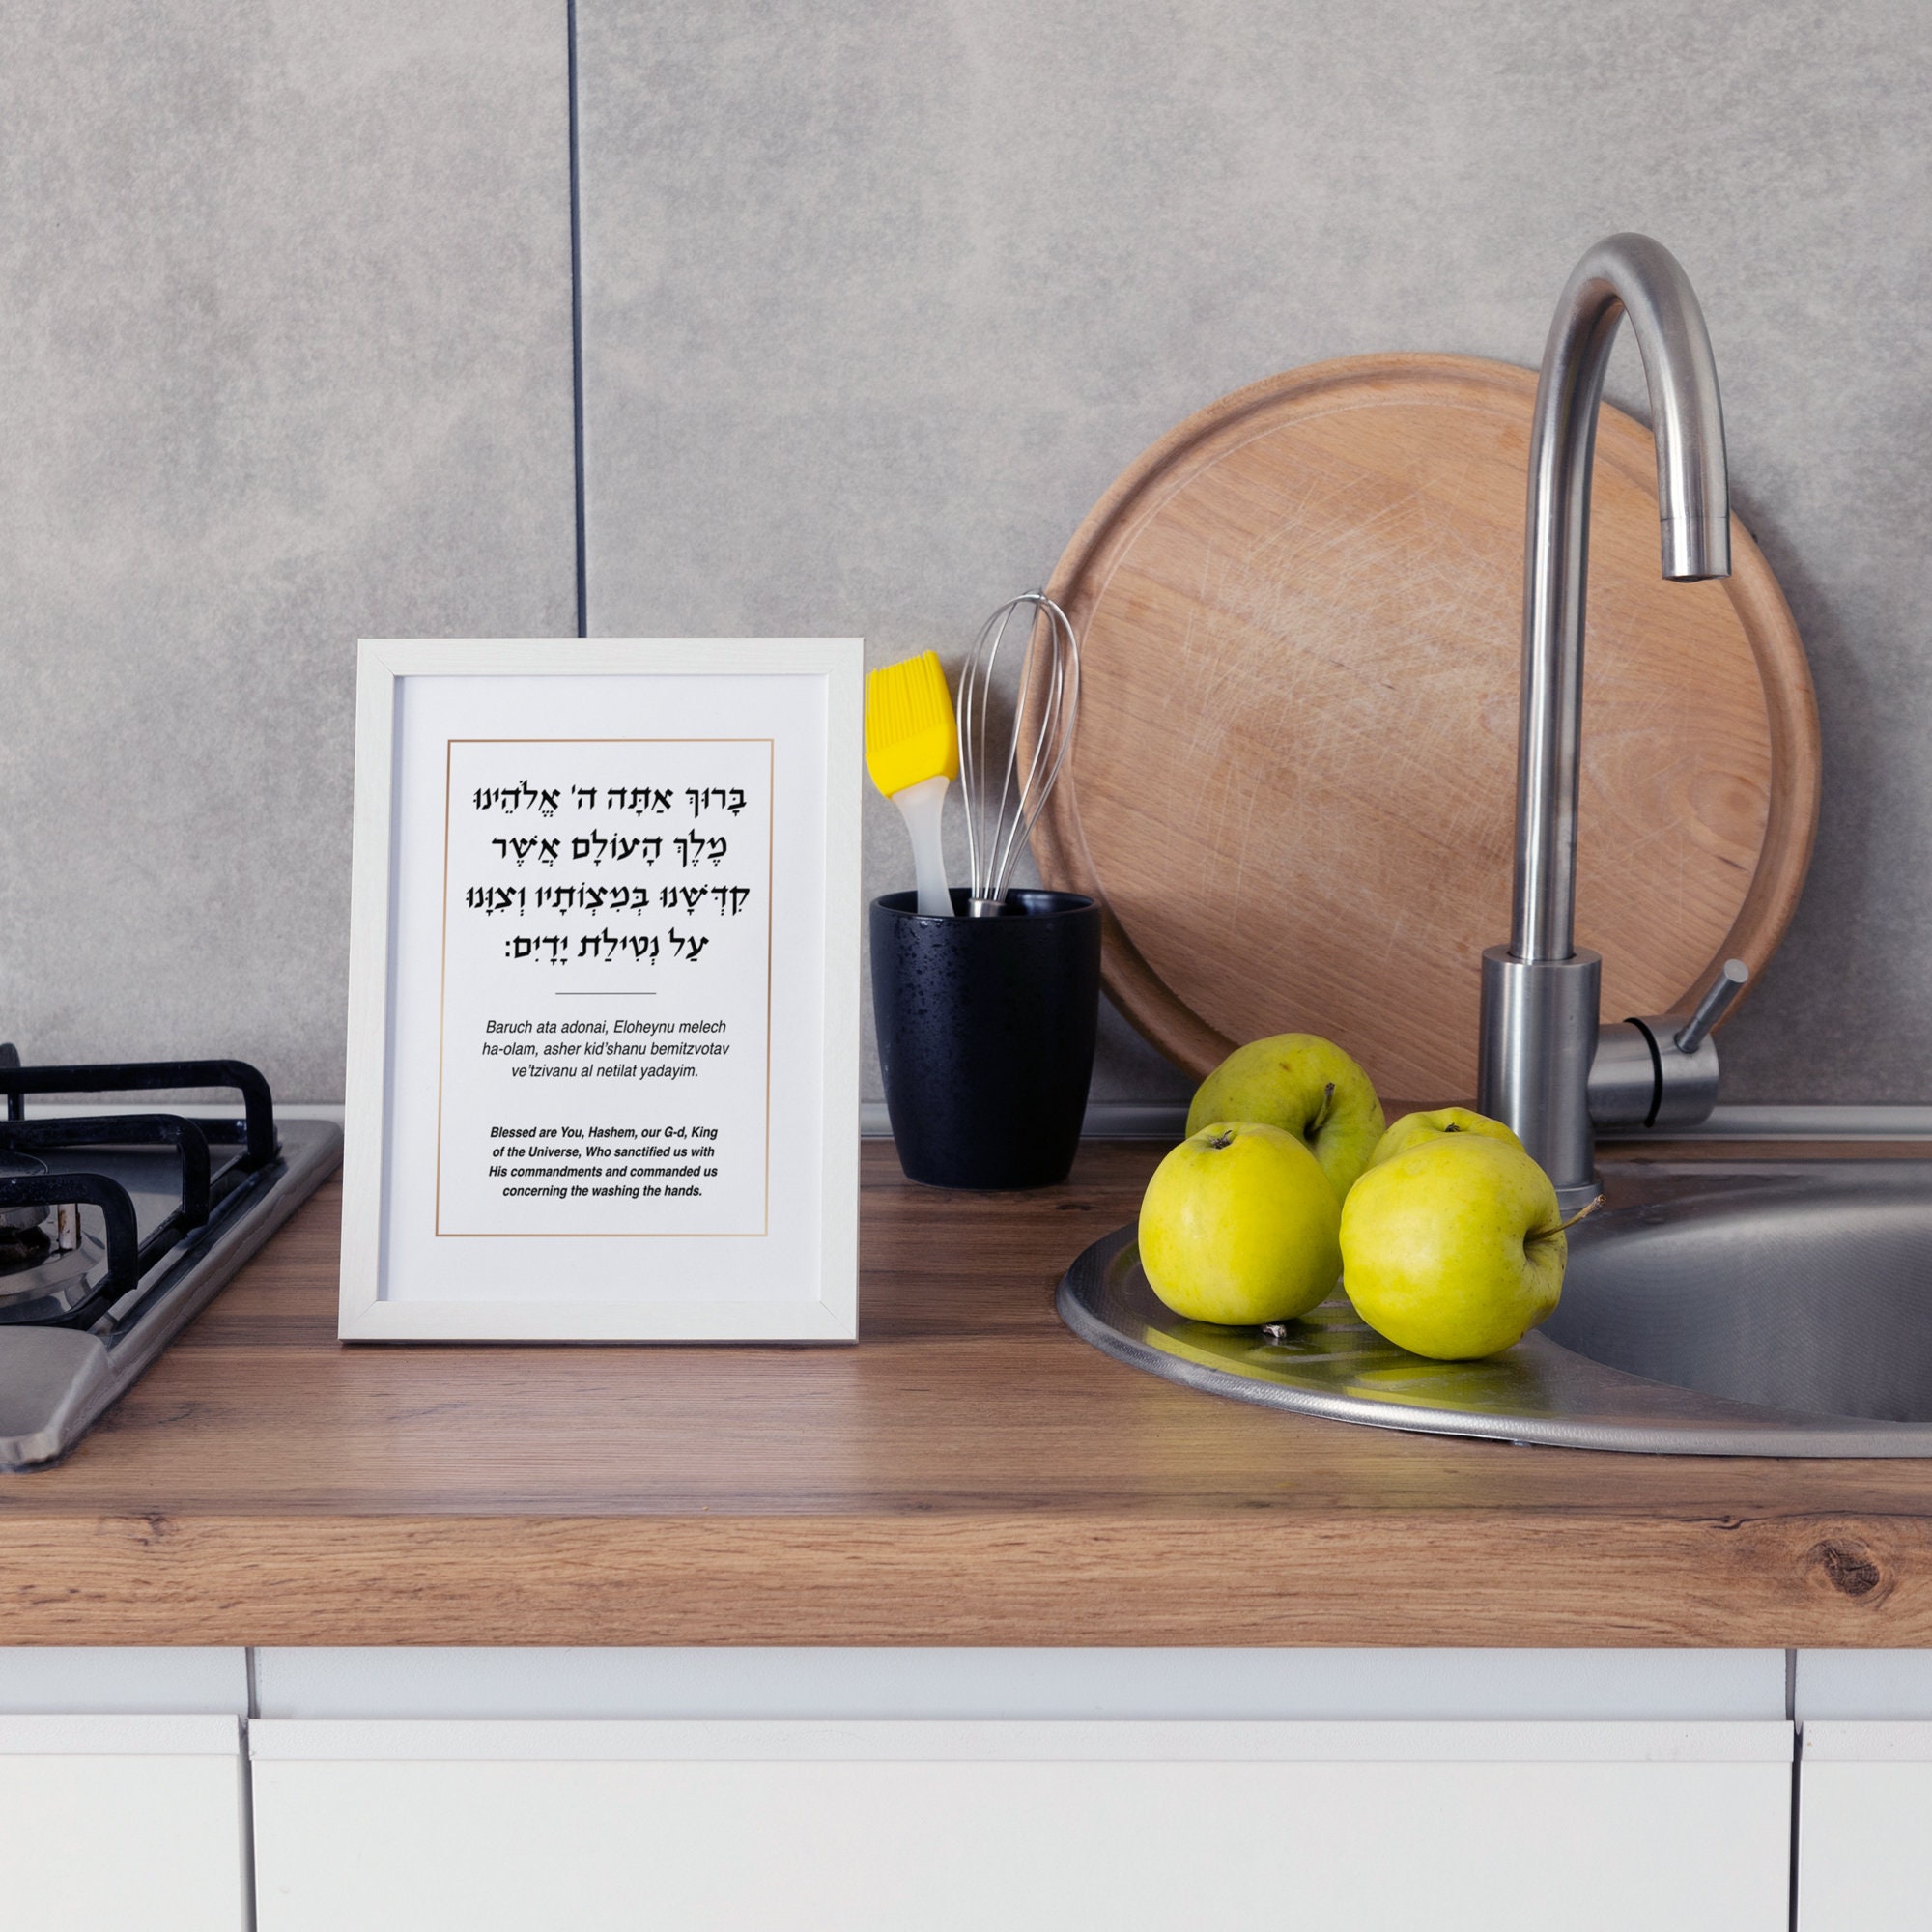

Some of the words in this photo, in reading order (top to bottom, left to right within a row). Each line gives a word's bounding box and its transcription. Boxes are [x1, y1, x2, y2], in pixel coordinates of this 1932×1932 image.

[485, 1019, 533, 1034] Baruch
[536, 1020, 557, 1034] ata
[560, 1019, 609, 1036] adonai,
[613, 1019, 675, 1037] Eloheynu
[678, 1019, 727, 1034] melech
[481, 1041, 539, 1058] ha-olam,
[543, 1041, 582, 1056] asher
[650, 1041, 730, 1056] bemitzvotav
[580, 1064, 594, 1078] al
[596, 1064, 638, 1078] netilat
[639, 1063, 698, 1081] yadayim.
[490, 1125, 538, 1139] Blessed
[538, 1128, 558, 1139] are
[560, 1125, 585, 1140] You,
[587, 1125, 639, 1140] Hashem,
[640, 1128, 663, 1138] our
[664, 1125, 688, 1140] G-d,
[691, 1125, 719, 1141] King
[492, 1146, 506, 1158] of
[506, 1146, 526, 1158] the
[527, 1146, 582, 1159] Universe,
[585, 1146, 612, 1158] Who
[613, 1145, 671, 1158] sanctified
[672, 1148, 688, 1158] us
[691, 1145, 716, 1158] with
[488, 1165, 508, 1178] His
[510, 1165, 603, 1178] commandments
[604, 1165, 629, 1178] and
[629, 1165, 702, 1178] commanded
[703, 1167, 719, 1178] us
[502, 1184, 568, 1200] concerning
[570, 1184, 589, 1197] the
[591, 1184, 640, 1200] washing
[642, 1184, 662, 1197] the
[663, 1184, 702, 1197] hands.
